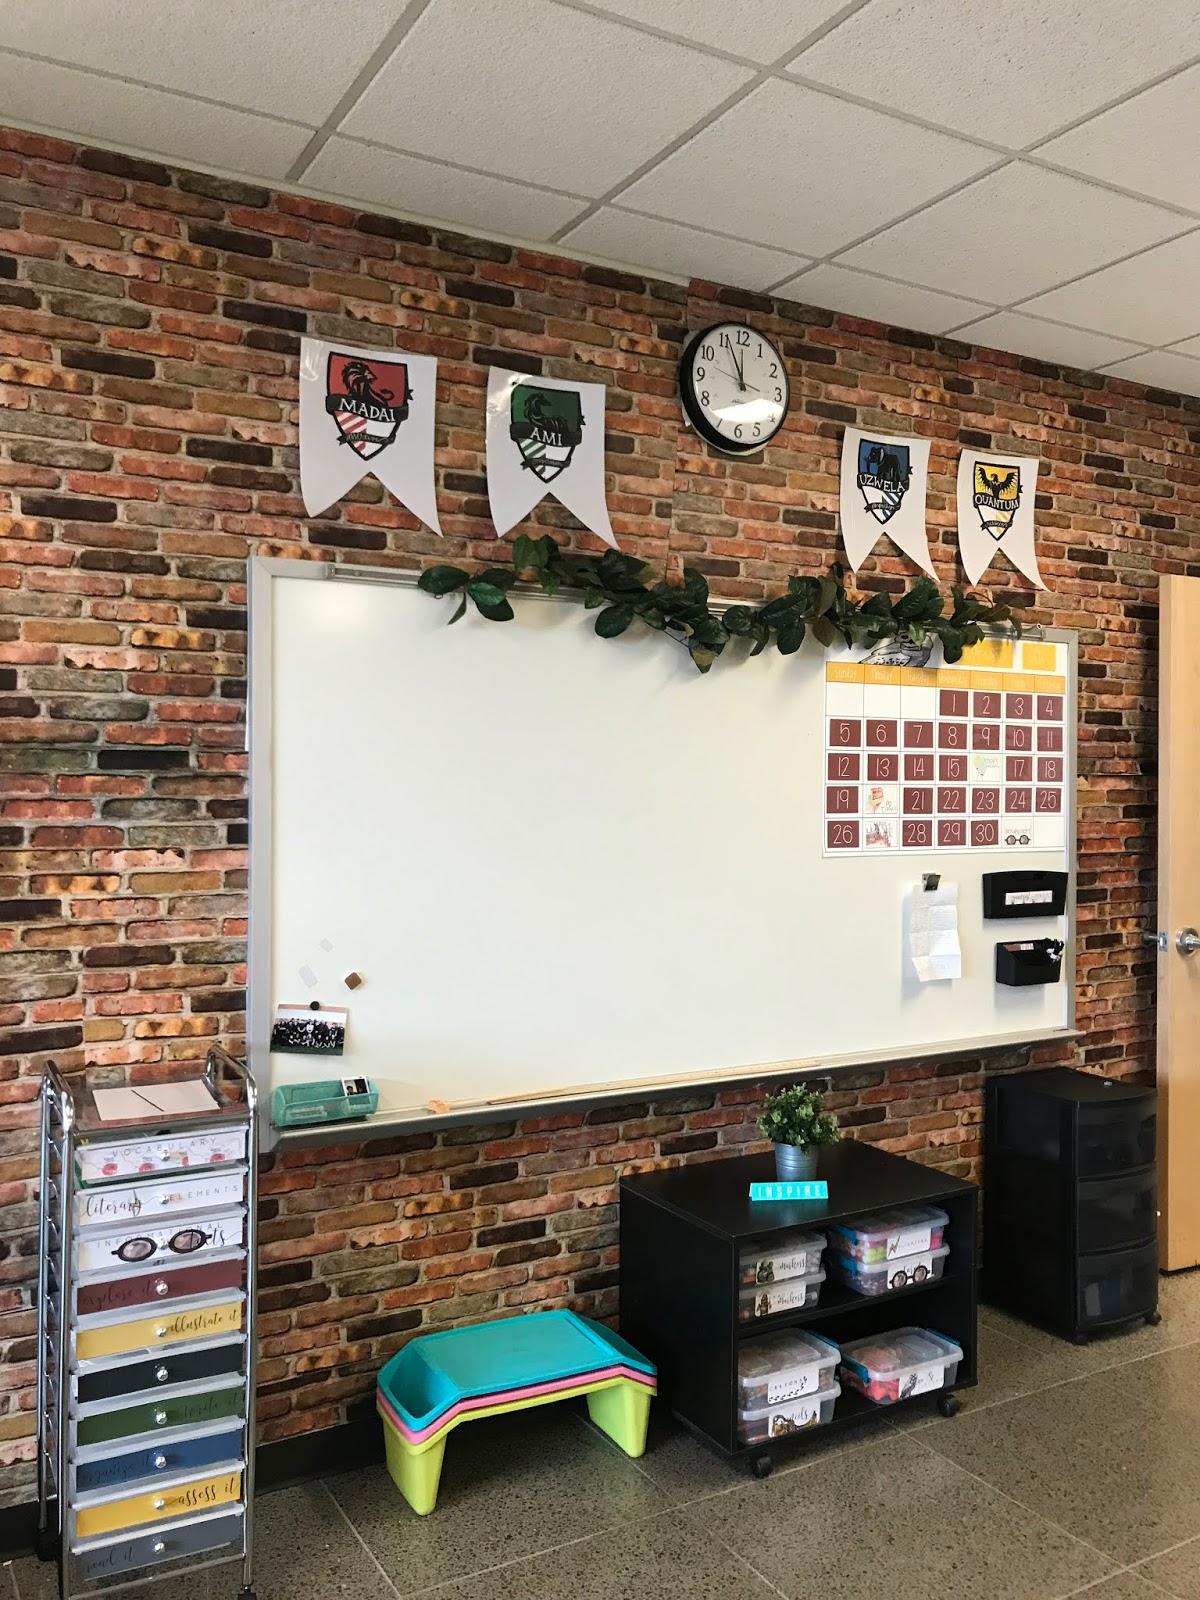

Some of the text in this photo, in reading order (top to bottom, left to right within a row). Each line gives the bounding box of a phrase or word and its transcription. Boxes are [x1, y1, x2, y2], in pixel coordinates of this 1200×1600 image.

[719, 332, 729, 349] 11
[736, 330, 751, 347] 12
[701, 344, 715, 361] 10
[757, 343, 763, 358] 1
[696, 367, 705, 382] 9
[769, 363, 778, 379] 2
[700, 390, 710, 406] 8
[774, 387, 783, 402] 3
[339, 398, 396, 422] MADAI
[530, 427, 562, 446] AMI
[734, 423, 743, 438] 6
[752, 422, 761, 437] 5
[860, 474, 906, 492] UZWELA
[975, 494, 1019, 510] QUANTUM
[834, 666, 857, 680] Sunday
[982, 695, 991, 715] 2
[1014, 697, 1024, 716] 3
[1045, 699, 1054, 717] 4
[839, 722, 1053, 749] 5 6 7 8 9 10 11
[838, 756, 850, 777] 12
[876, 757, 890, 778] 13
[913, 758, 925, 777] 14
[947, 758, 960, 778] 15
[1014, 759, 1025, 778] 17
[1044, 760, 1056, 779] 18
[836, 789, 850, 810] 19
[911, 791, 925, 811] 21
[942, 790, 960, 810] 22
[976, 791, 995, 810] 23
[1010, 791, 1026, 810] 24
[1039, 791, 1057, 809] 25
[833, 824, 853, 845] 26
[907, 823, 927, 843] 28
[943, 823, 961, 843] 29
[975, 823, 995, 843] 30
[112, 1138, 217, 1158] VOCABULARY
[169, 1184, 238, 1201] ELEMENTS
[757, 1184, 821, 1198] INSPIRE
[169, 1309, 239, 1333] illustrate it
[177, 1476, 235, 1507] assess it
[87, 1546, 134, 1573] read it
